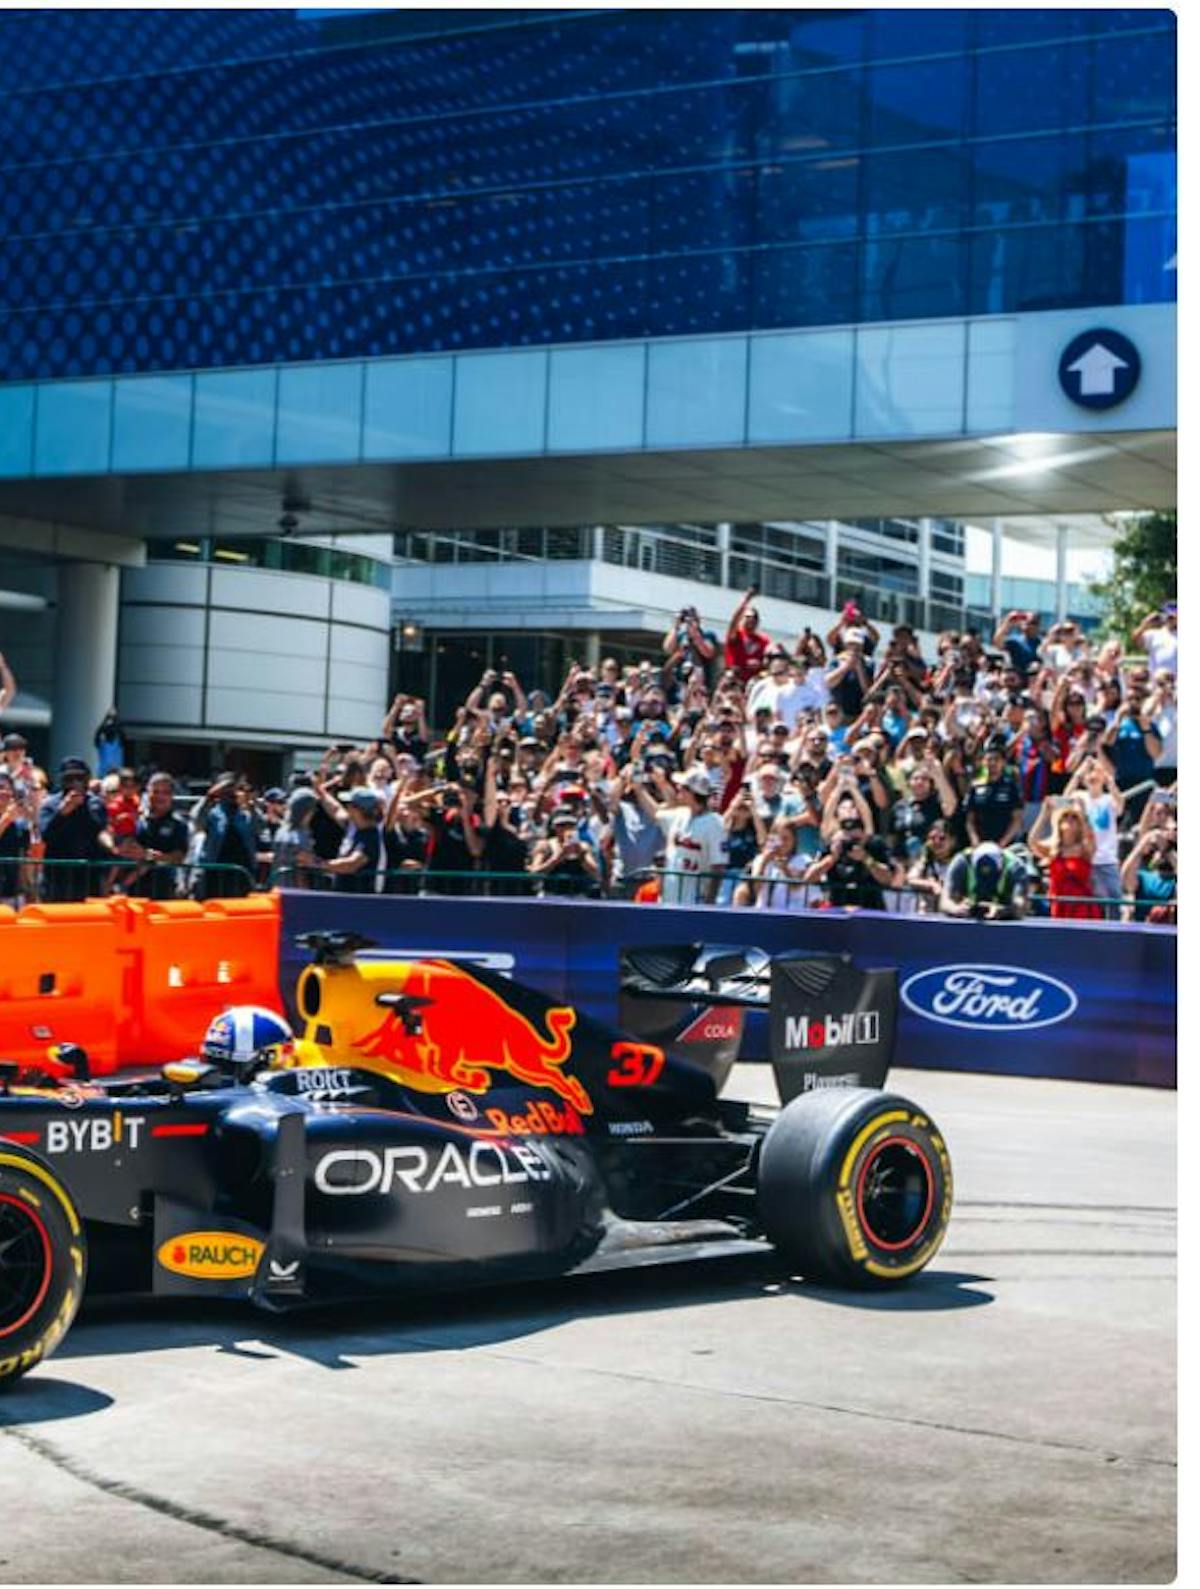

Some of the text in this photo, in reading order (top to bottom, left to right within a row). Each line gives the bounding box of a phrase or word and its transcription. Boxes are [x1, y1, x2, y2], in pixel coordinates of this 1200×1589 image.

[932, 971, 1043, 1021] Ford
[703, 1024, 736, 1039] COLA
[785, 1014, 856, 1049] Mobil
[607, 1041, 667, 1087] 37
[47, 1110, 146, 1154] BYBIT
[314, 1139, 548, 1195] ORACLE
[189, 1244, 257, 1265] RAUCH
